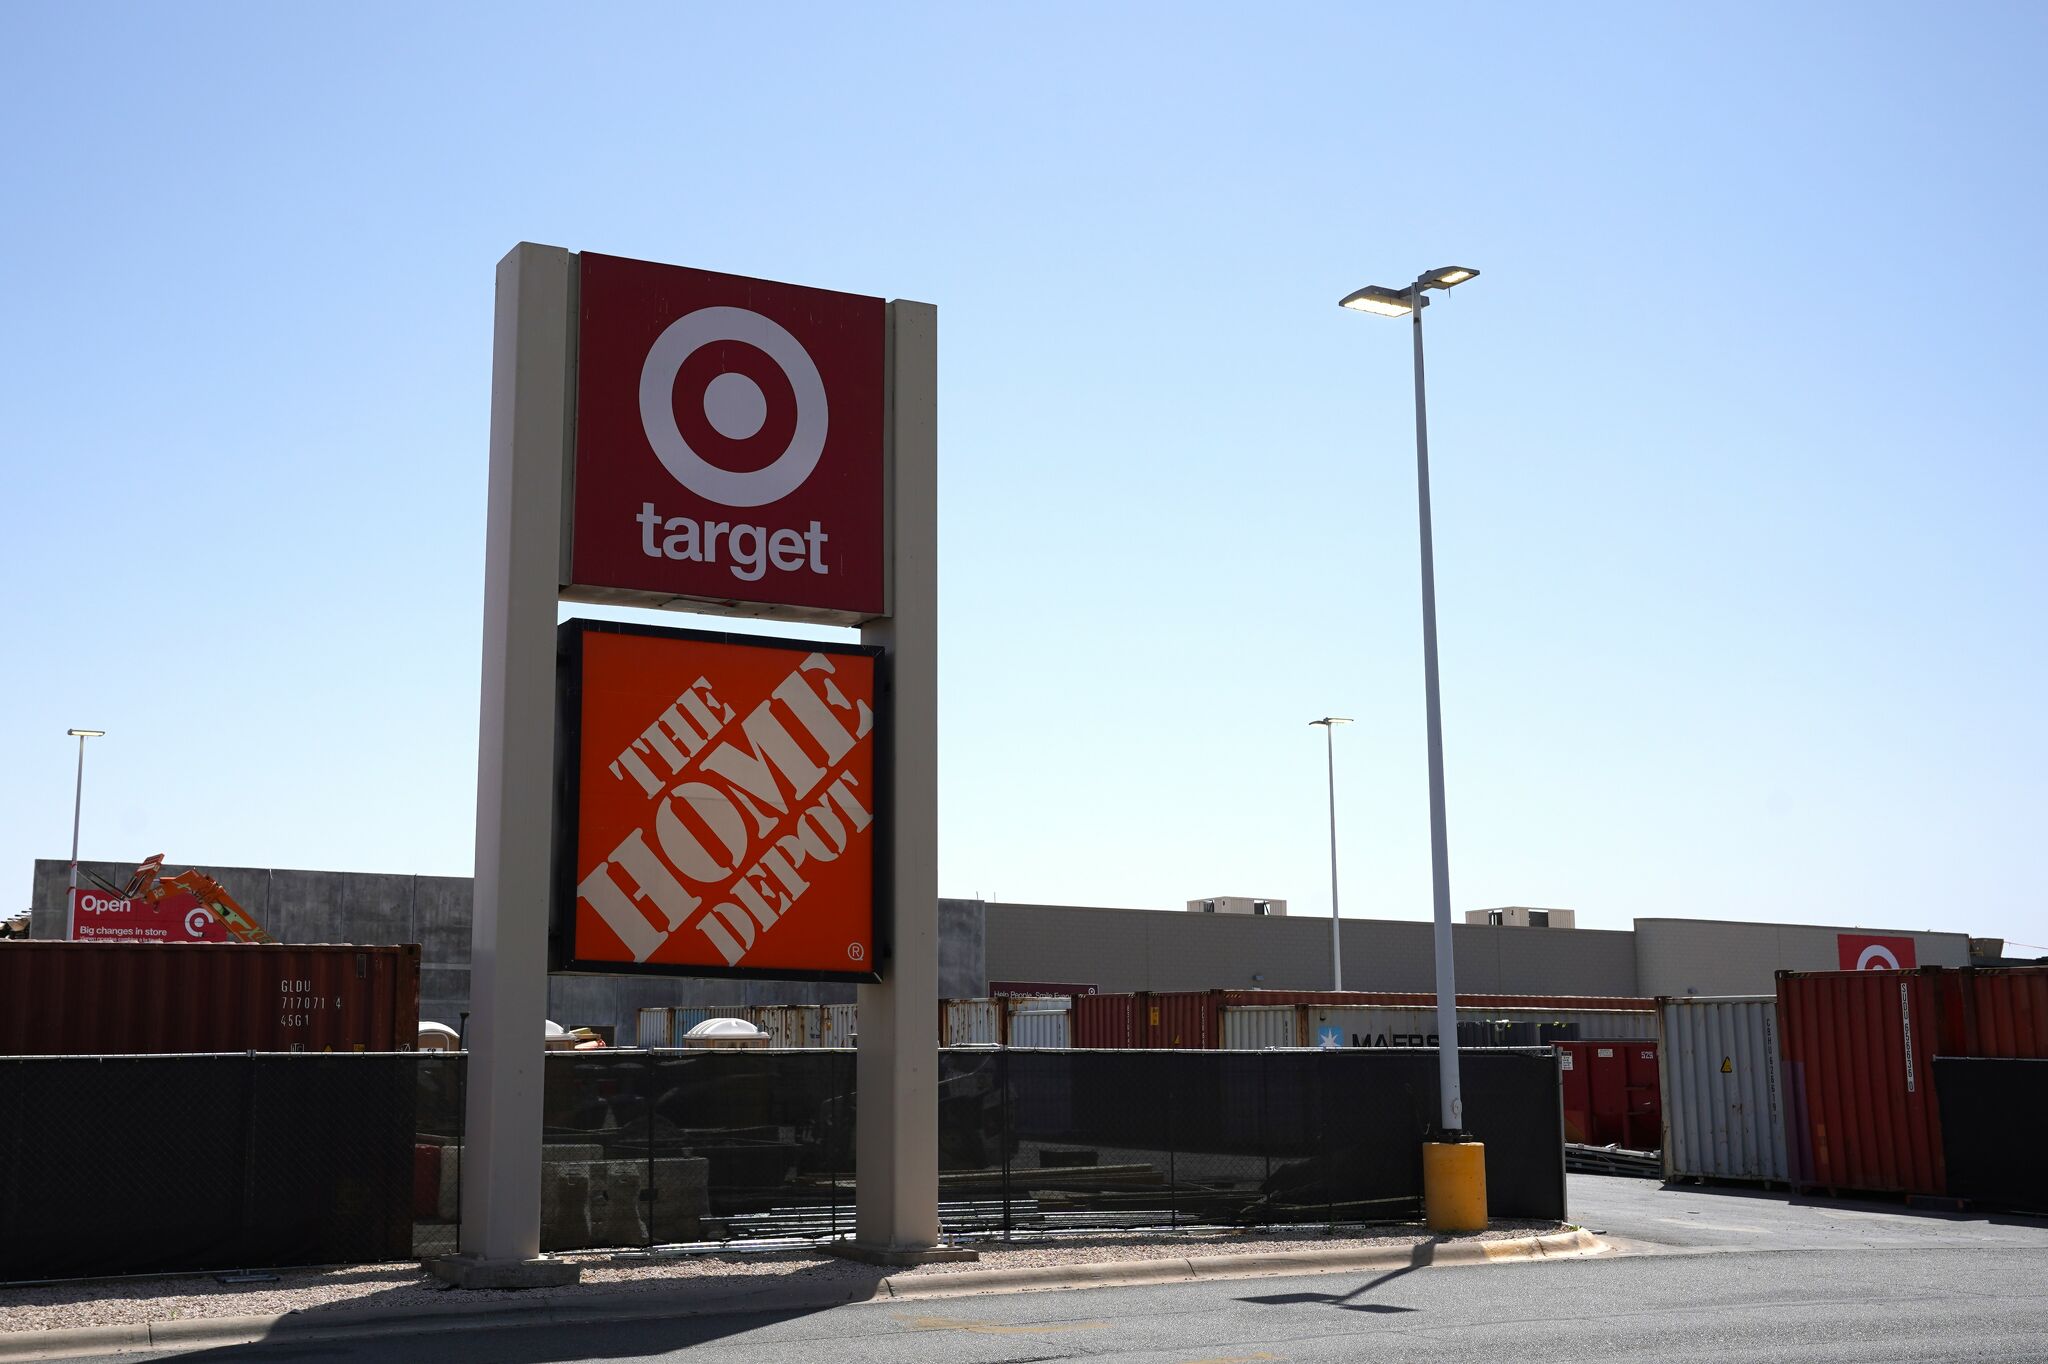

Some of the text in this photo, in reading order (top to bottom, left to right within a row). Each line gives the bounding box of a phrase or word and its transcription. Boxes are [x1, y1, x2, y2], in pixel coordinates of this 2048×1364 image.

[636, 502, 828, 581] target
[608, 675, 736, 799] THE
[577, 652, 873, 963] HOME
[696, 770, 873, 966] DEPOT
[81, 894, 131, 914] Open
[80, 926, 167, 937] Big changes in store
[281, 980, 311, 992] GLDU
[282, 996, 342, 1009] 717071 4
[280, 1014, 310, 1027] 45G1
